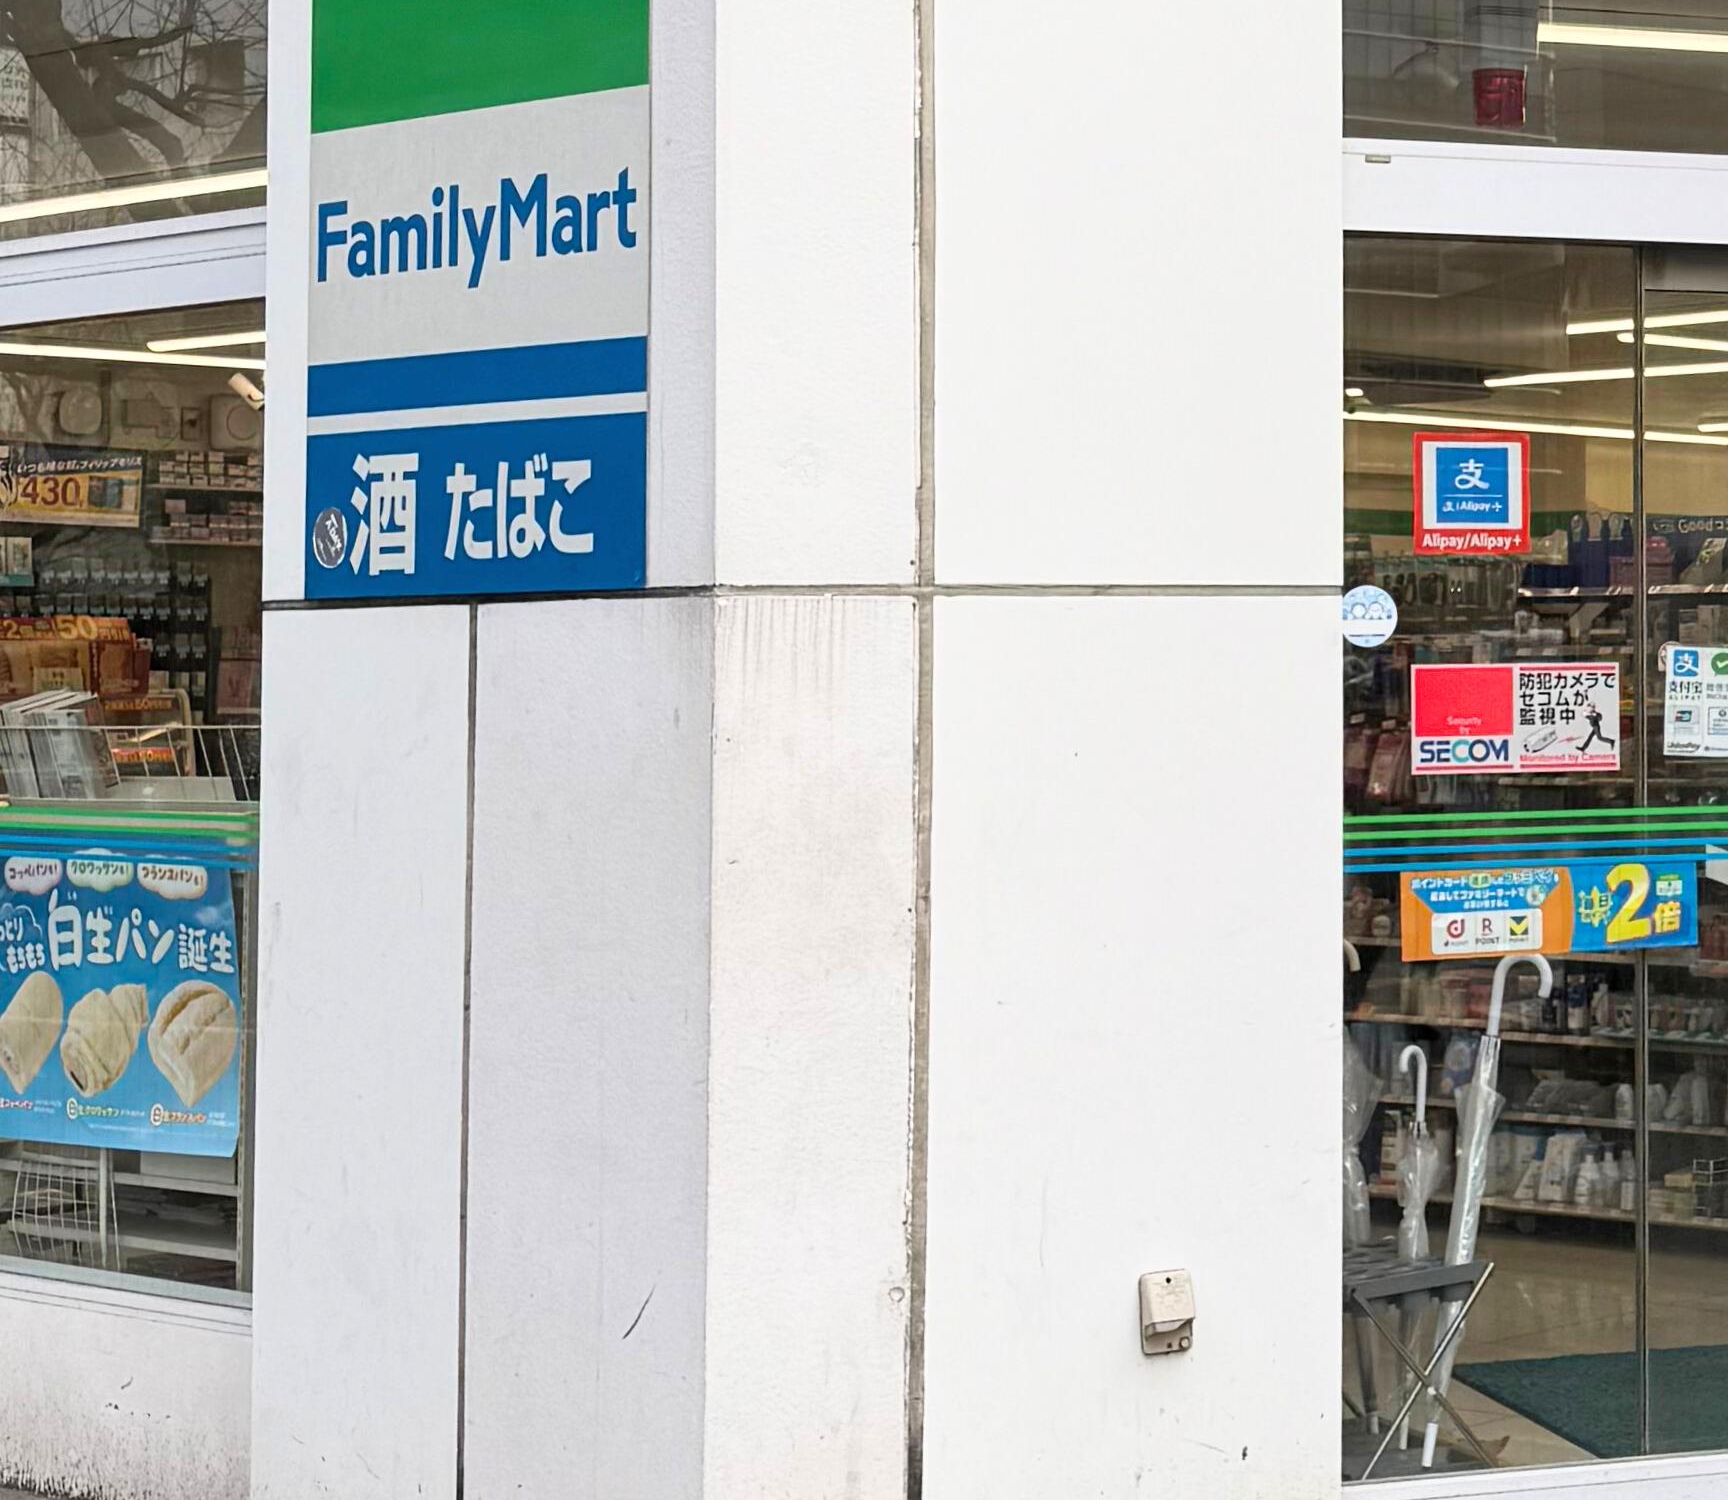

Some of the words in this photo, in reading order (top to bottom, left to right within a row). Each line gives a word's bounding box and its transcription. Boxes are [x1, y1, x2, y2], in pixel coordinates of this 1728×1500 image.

[316, 166, 638, 288] FamilyMart
[20, 475, 81, 507] 430
[350, 453, 419, 576] 酒
[444, 453, 594, 561] たばこ
[1422, 533, 1522, 551] Alipay/Alipay+
[1519, 673, 1616, 691] 防犯カメラで
[1519, 690, 1589, 707] セコムが
[1519, 708, 1576, 726] 監視中
[1420, 739, 1509, 763] SECOM
